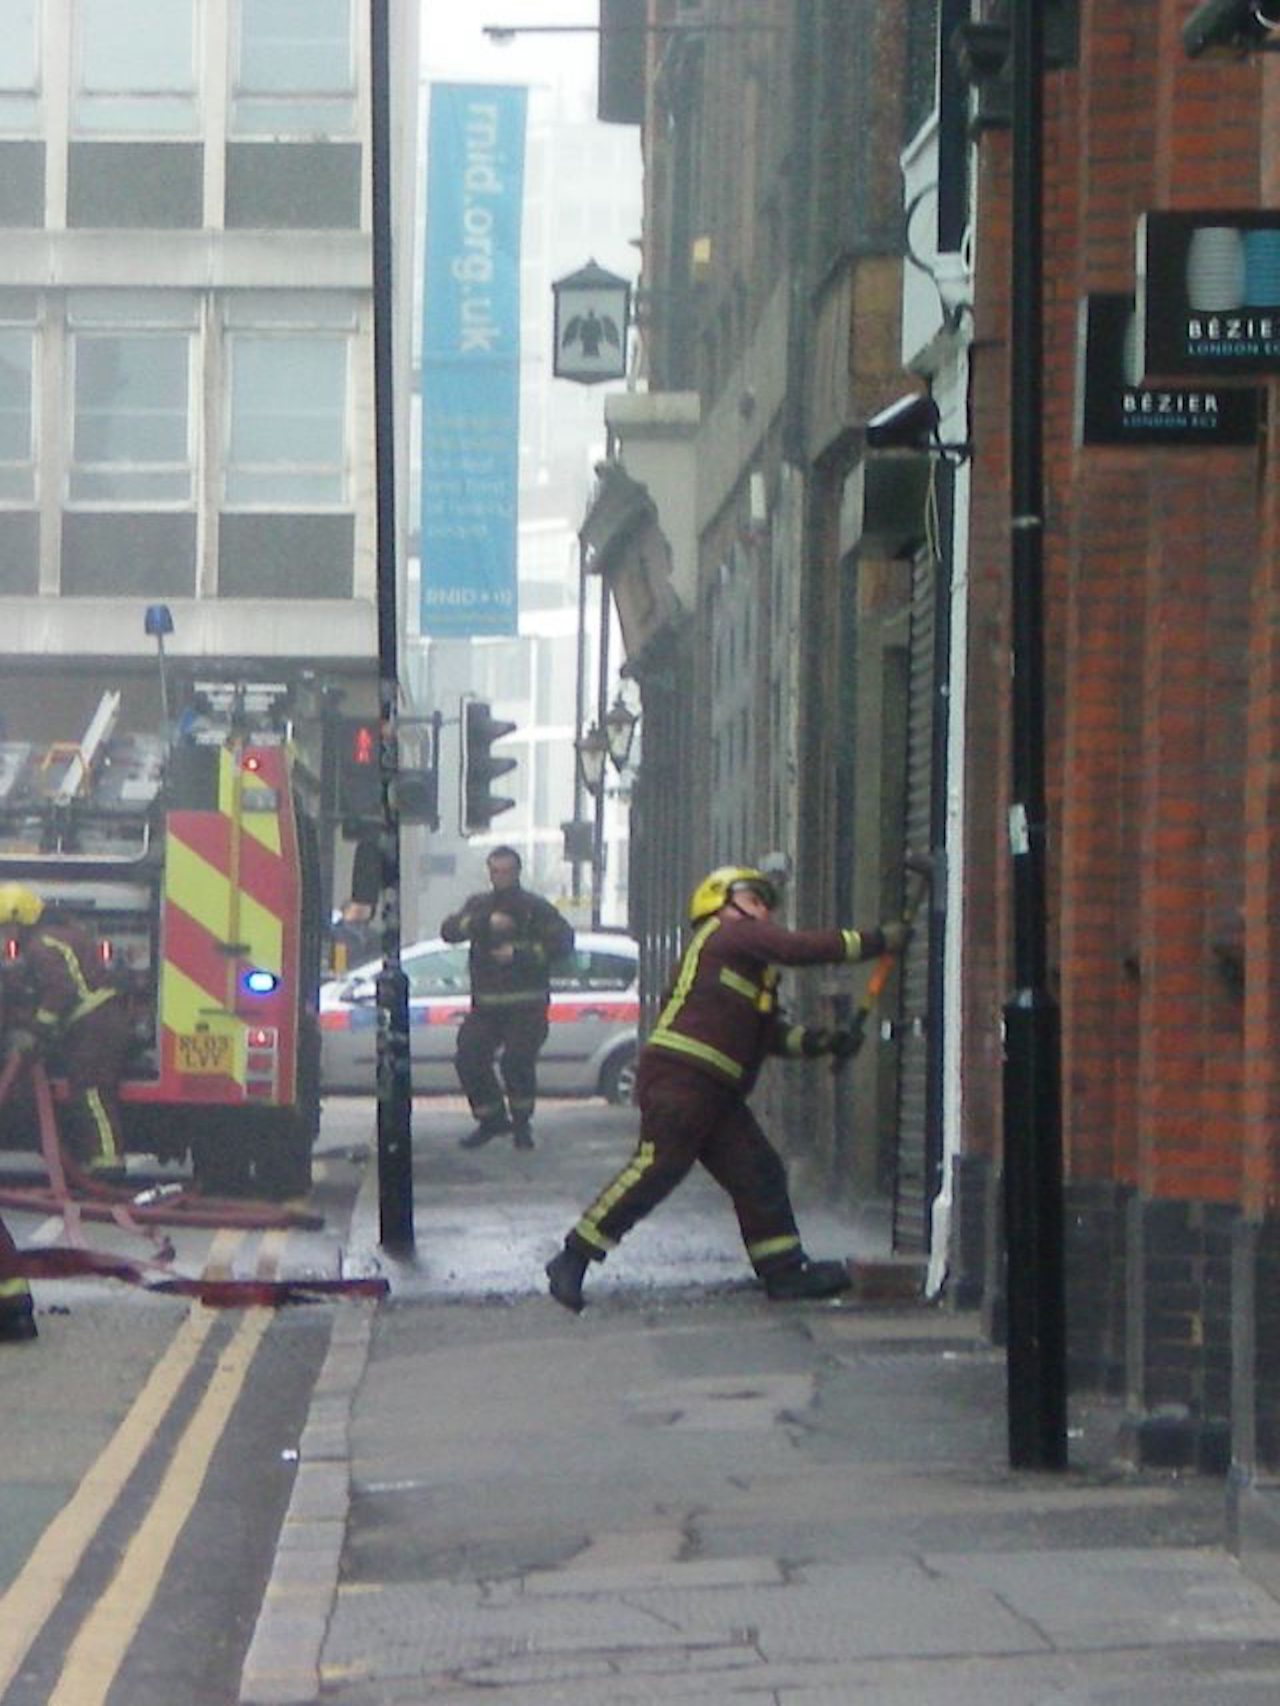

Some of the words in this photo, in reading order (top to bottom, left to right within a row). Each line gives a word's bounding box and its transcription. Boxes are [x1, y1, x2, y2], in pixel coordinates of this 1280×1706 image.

[451, 103, 503, 351] rnid.org.uk
[1188, 317, 1273, 339] BÉZIE
[1188, 342, 1259, 355] LONDON
